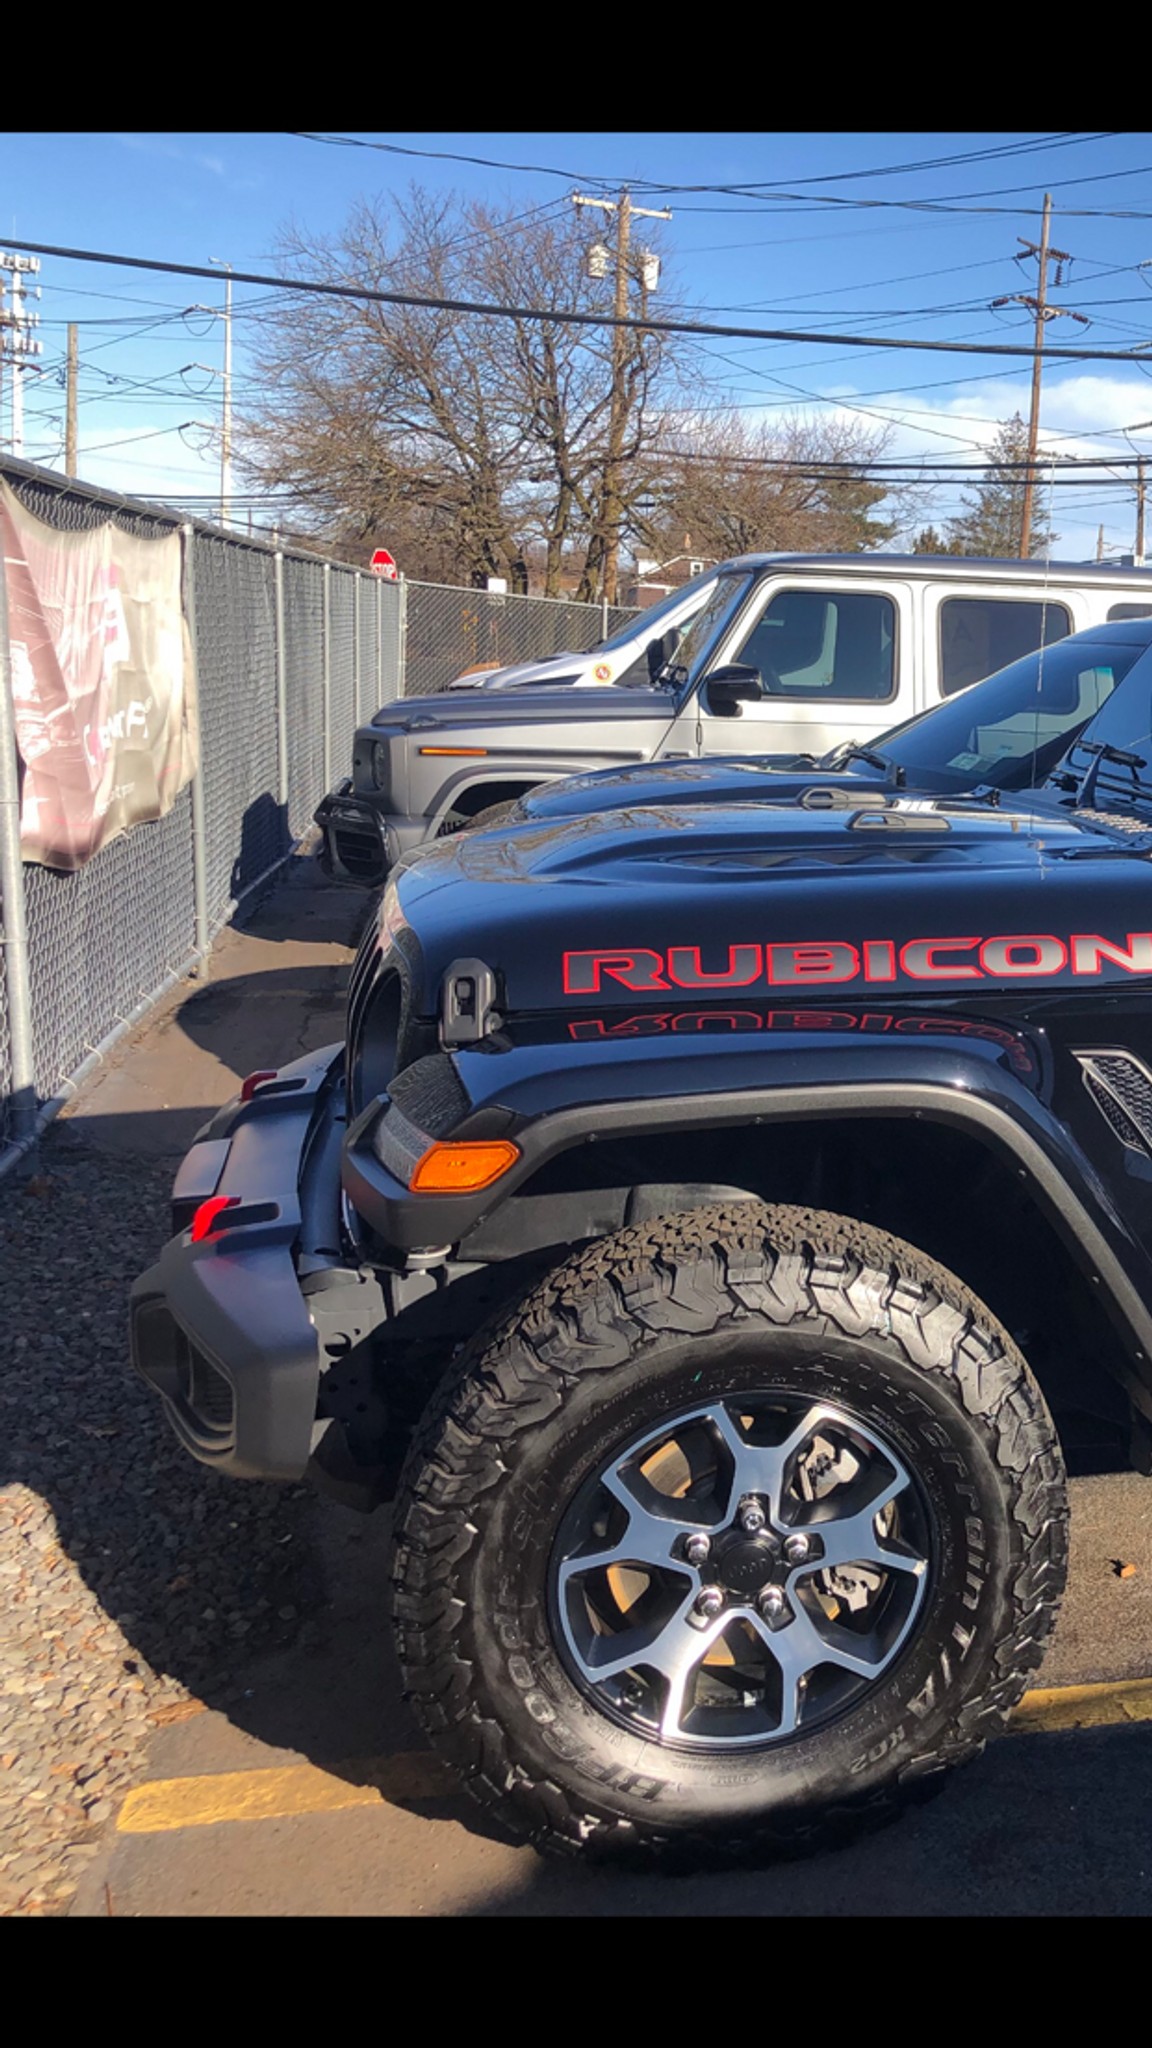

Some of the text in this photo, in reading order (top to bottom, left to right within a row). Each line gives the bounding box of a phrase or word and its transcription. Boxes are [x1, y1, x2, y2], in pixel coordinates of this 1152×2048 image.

[370, 563, 396, 579] STOP
[563, 933, 1152, 994] RUBICON
[906, 1622, 977, 1720] T/A
[849, 1723, 905, 1775] KO2
